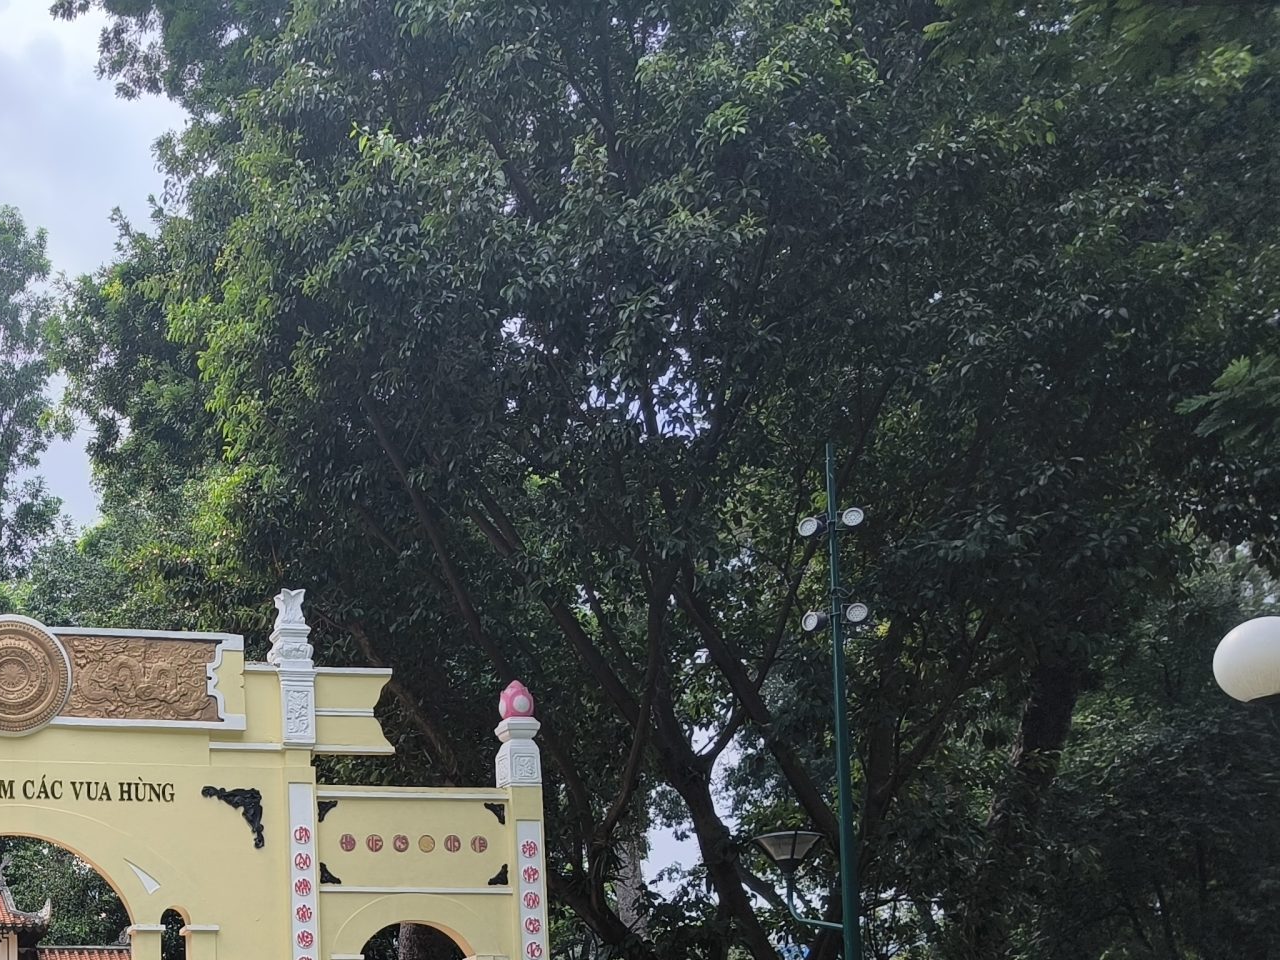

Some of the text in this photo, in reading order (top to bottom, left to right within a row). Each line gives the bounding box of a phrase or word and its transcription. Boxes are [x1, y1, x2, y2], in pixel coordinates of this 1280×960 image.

[22, 774, 63, 800] CÁC
[70, 780, 113, 801] VUA
[118, 776, 176, 802] HÙNG
